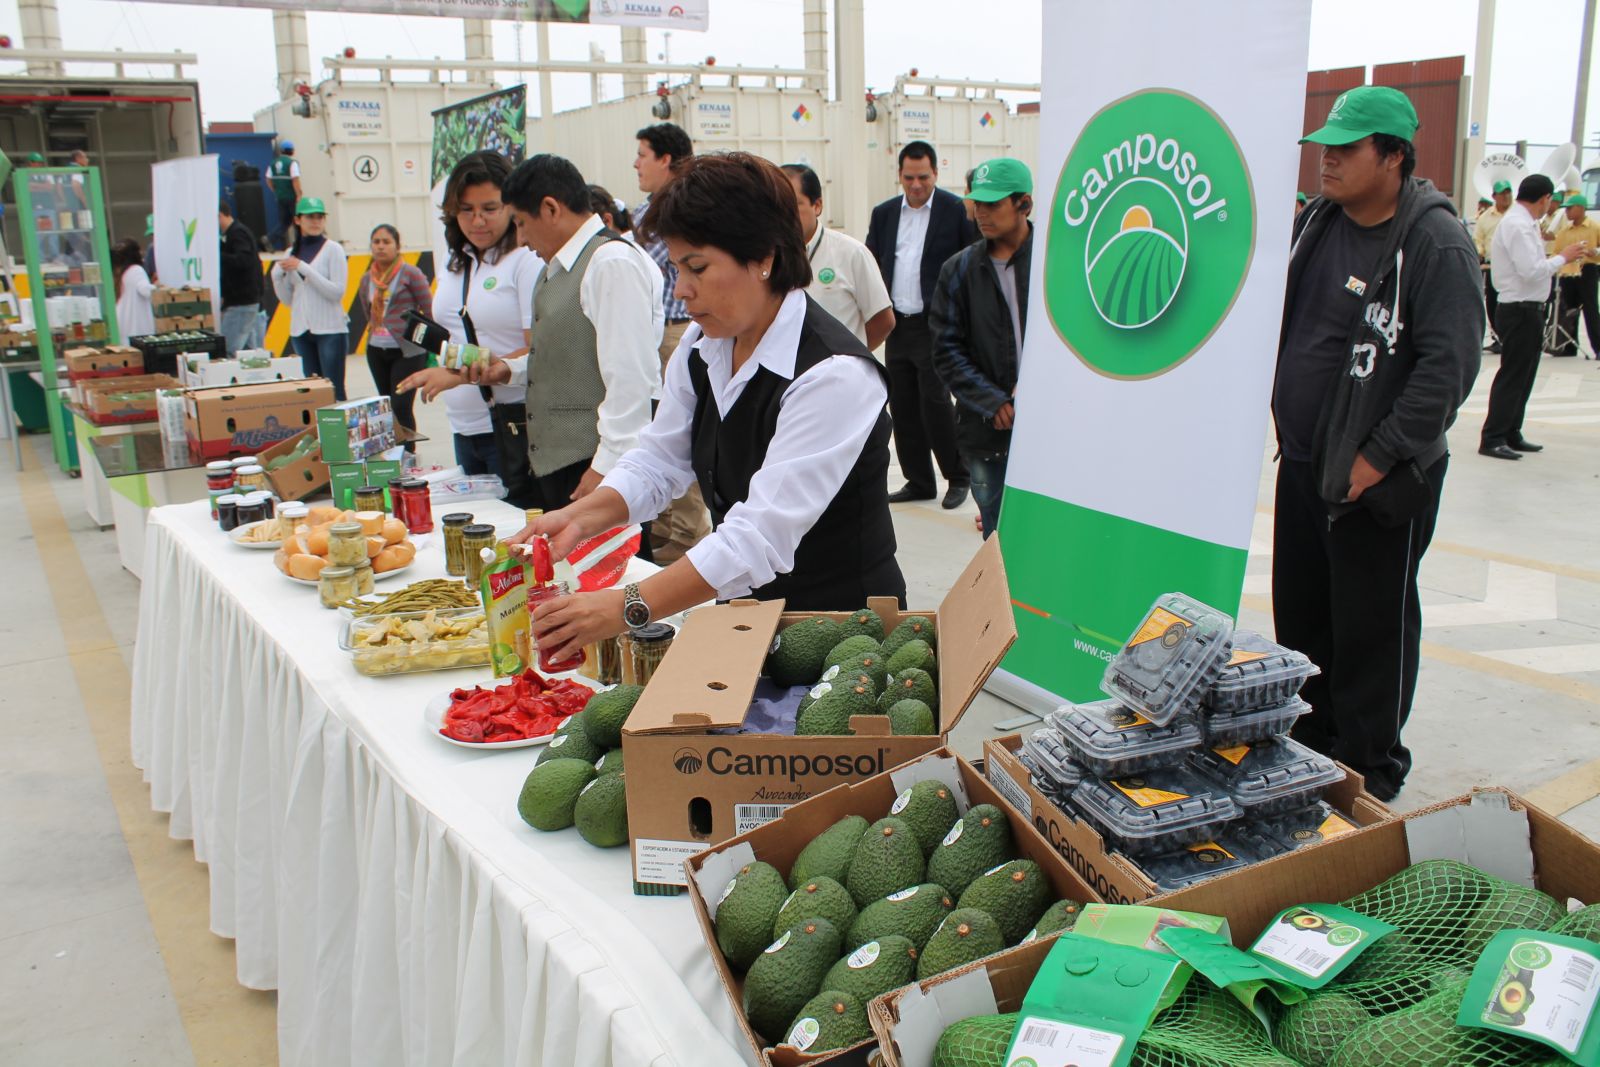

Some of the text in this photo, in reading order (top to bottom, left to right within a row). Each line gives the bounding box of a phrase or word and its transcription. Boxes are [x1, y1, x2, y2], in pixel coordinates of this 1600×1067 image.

[503, 0, 529, 8] Soles
[624, 3, 662, 13] SENASA
[339, 101, 381, 110] SENASA
[698, 104, 732, 112] SENASA
[903, 111, 930, 119] SENASA
[360, 159, 373, 178] 4
[1063, 133, 1226, 227] Camposol
[706, 746, 884, 782] Camposol
[752, 784, 812, 801] Avocados
